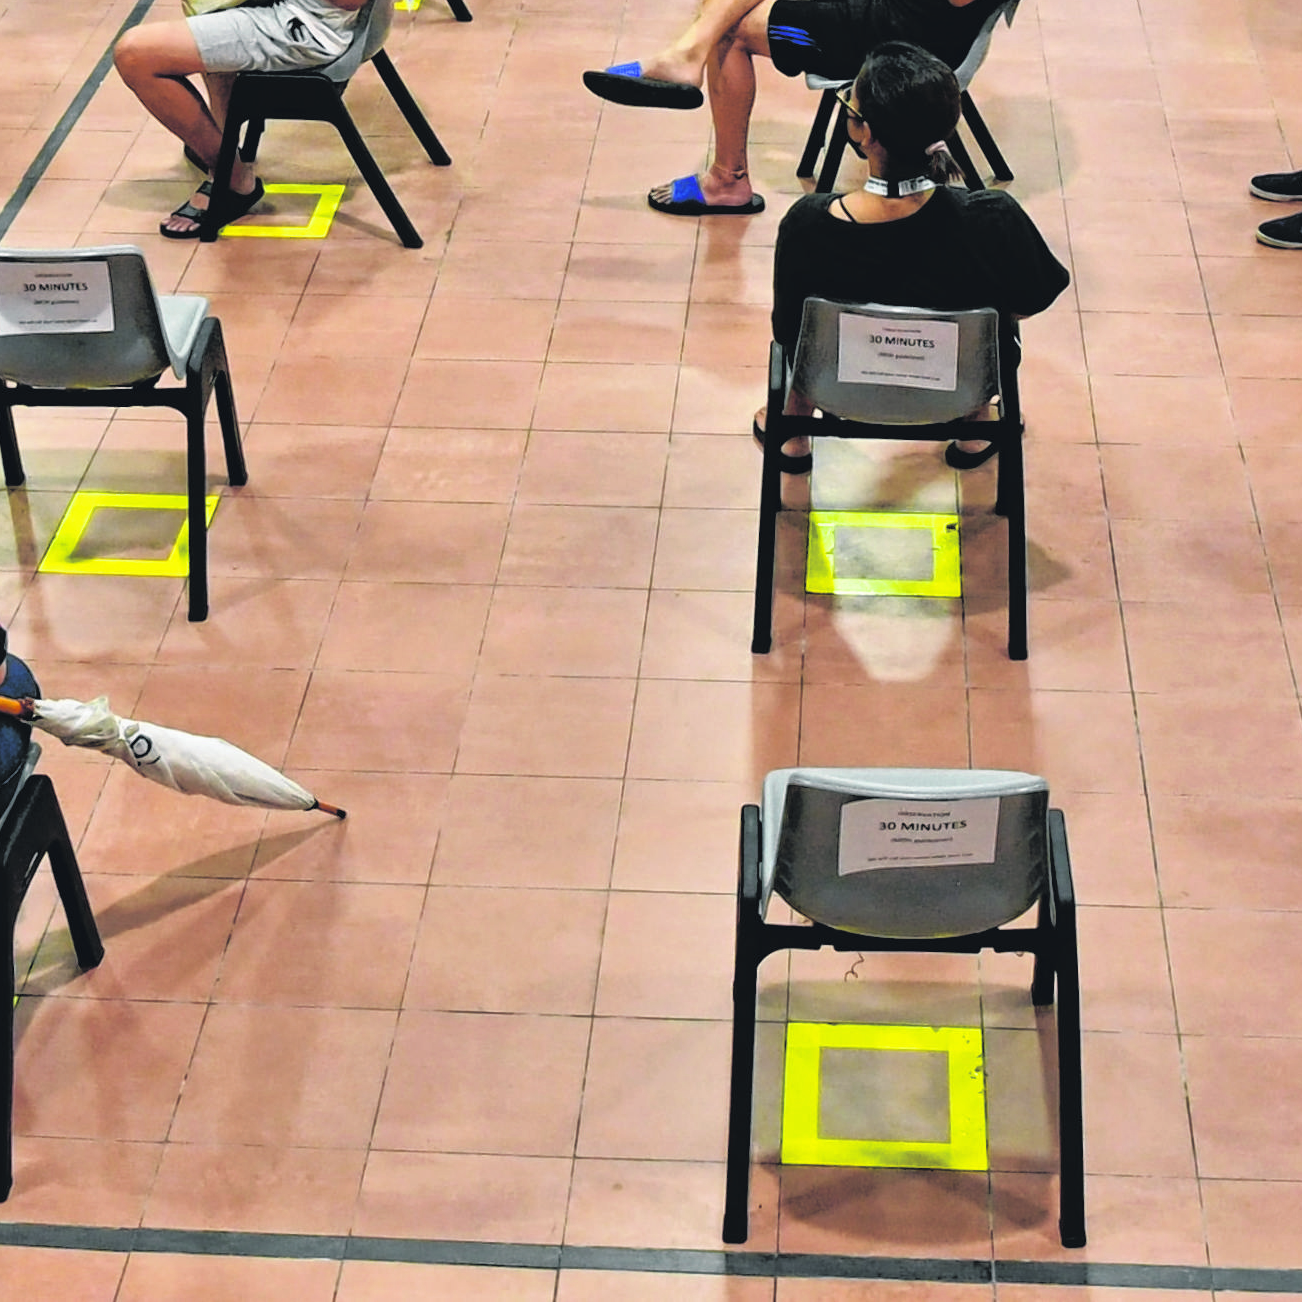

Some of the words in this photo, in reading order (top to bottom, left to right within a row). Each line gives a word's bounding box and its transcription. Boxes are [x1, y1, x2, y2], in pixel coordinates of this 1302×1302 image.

[24, 283, 36, 292] 30
[39, 283, 88, 291] MINUTES
[869, 335, 882, 344] 30
[885, 336, 935, 348] MINUTES
[879, 821, 896, 831] 30
[901, 820, 967, 831] MINUTES
